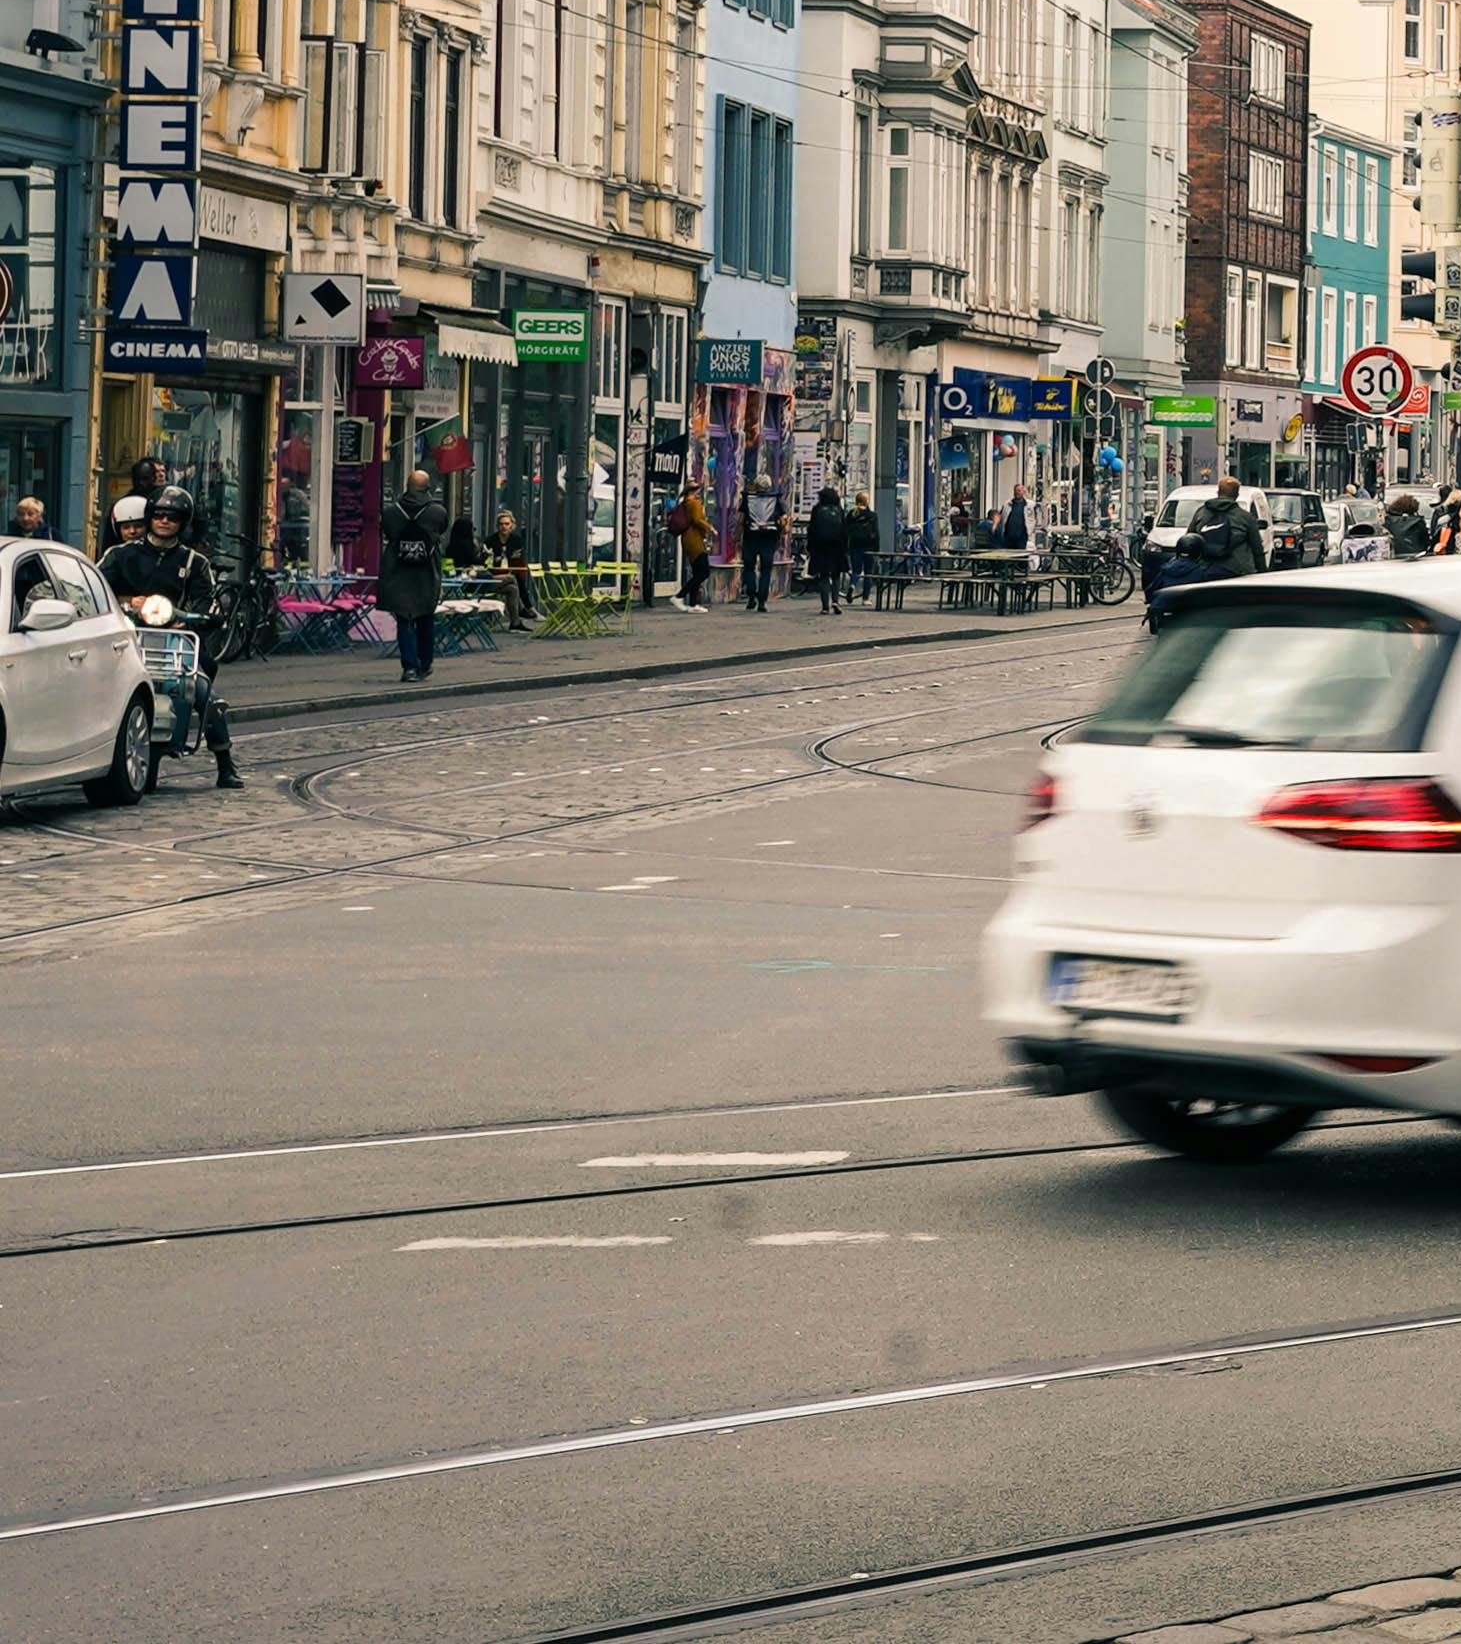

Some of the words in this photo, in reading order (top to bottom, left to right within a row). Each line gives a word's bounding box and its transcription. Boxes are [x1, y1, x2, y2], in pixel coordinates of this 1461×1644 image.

[518, 319, 582, 335] GEERS
[110, 341, 202, 359] CINEMA
[518, 344, 580, 355] HÖRGERÄTE
[710, 344, 751, 353] ANZIEH
[710, 352, 750, 362] UNGS
[710, 362, 751, 372] PUNKT.
[1356, 366, 1397, 397] 30
[943, 387, 973, 416] O2
